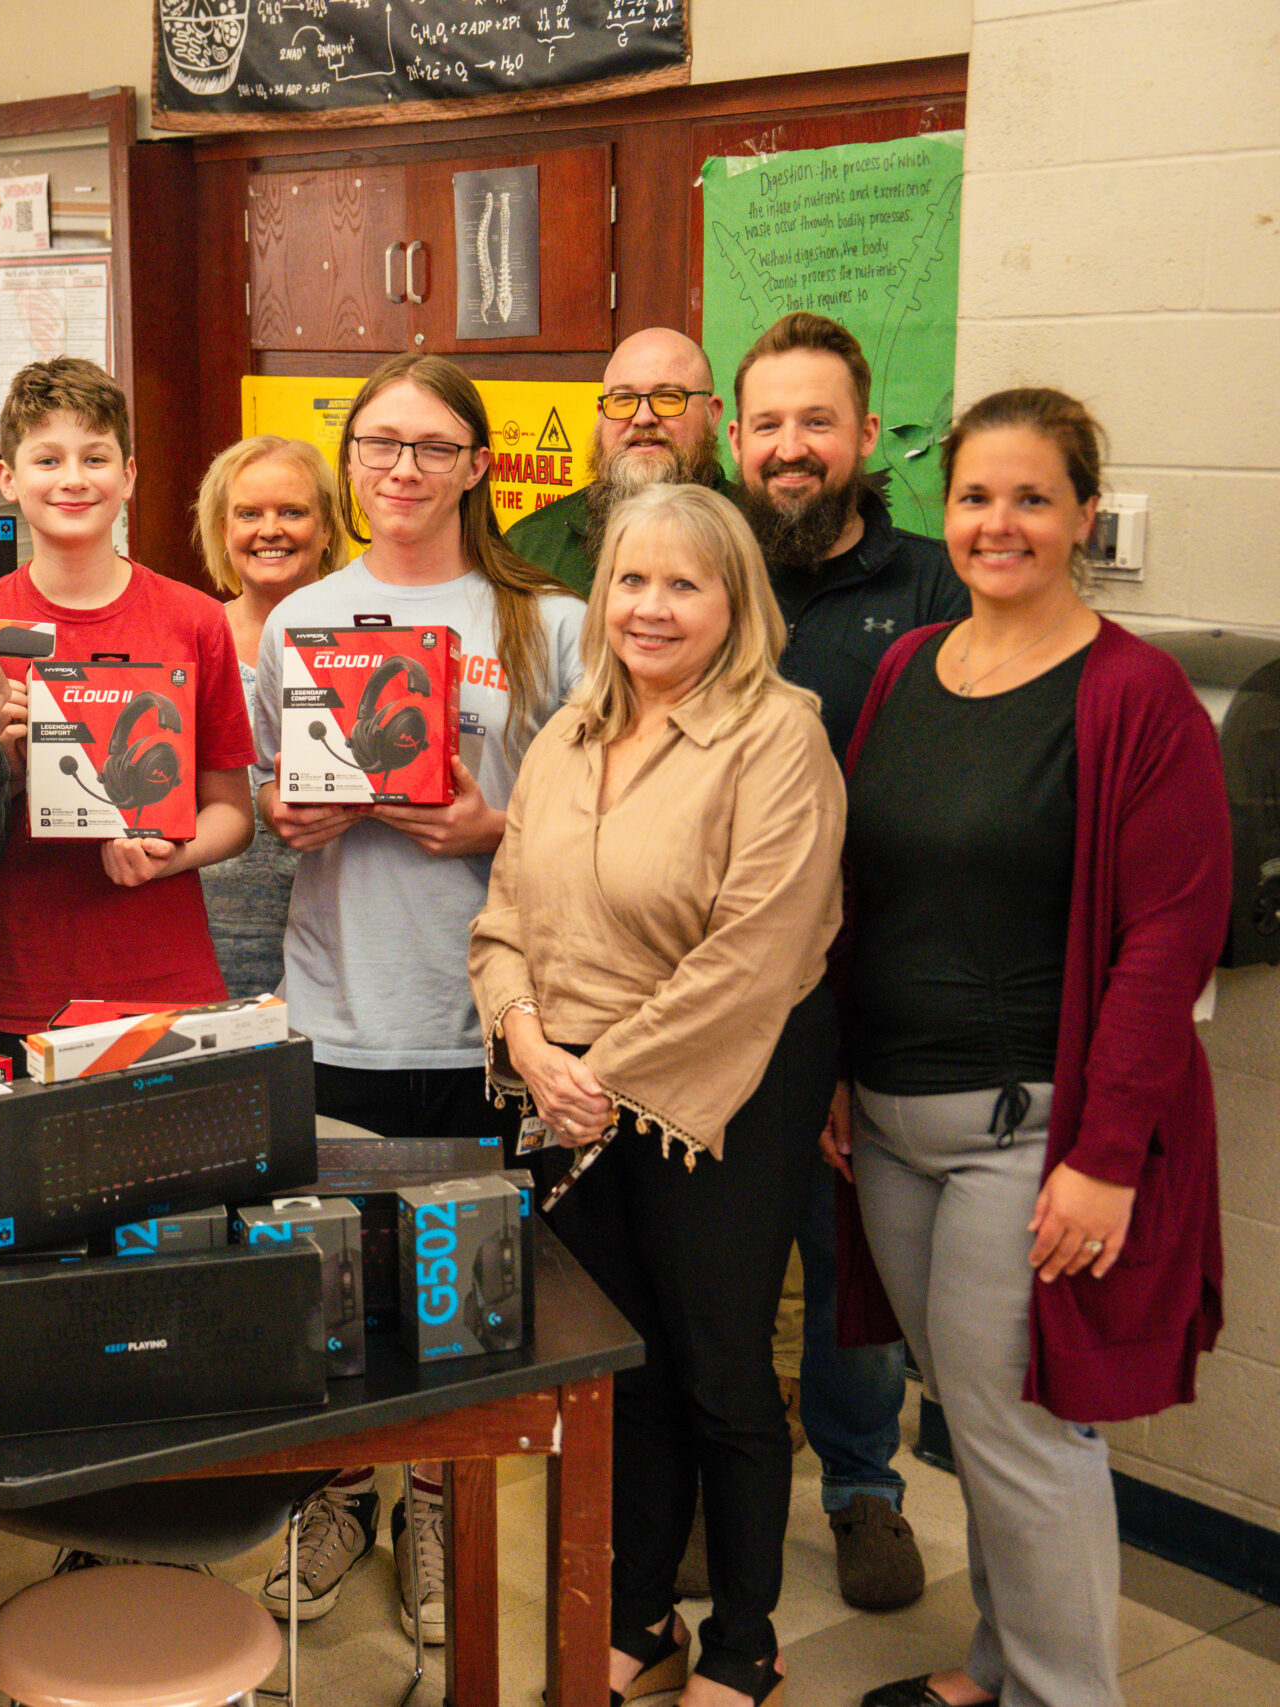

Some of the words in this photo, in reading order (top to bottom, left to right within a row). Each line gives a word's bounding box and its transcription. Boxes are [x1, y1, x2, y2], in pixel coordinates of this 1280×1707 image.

[820, 160, 838, 182] the
[844, 156, 880, 183] process
[883, 152, 896, 172] of
[898, 150, 930, 169] which
[748, 201, 763, 219] the
[767, 200, 792, 218] intake
[793, 194, 801, 212] of
[804, 188, 845, 208] nutrients
[849, 185, 869, 202] and
[873, 181, 919, 198] excretion
[920, 179, 932, 196] of
[745, 222, 771, 240] waste
[775, 218, 797, 235] occur
[800, 213, 834, 237] through
[843, 241, 858, 257] the
[862, 237, 889, 259] body
[802, 269, 836, 289] process
[840, 265, 852, 280] the
[855, 262, 897, 279] nutrients
[787, 294, 803, 311] that
[817, 290, 853, 311] requires
[858, 288, 868, 303] to
[496, 490, 523, 510] FIRE
[313, 654, 370, 668] CLOUD
[371, 654, 383, 668] II
[45, 667, 78, 678] HYPERX
[63, 689, 120, 703] CLOUD
[121, 689, 133, 703] II
[415, 1200, 458, 1326] G502
[105, 1343, 127, 1353] KEEP
[128, 1339, 167, 1351] PLAYING
